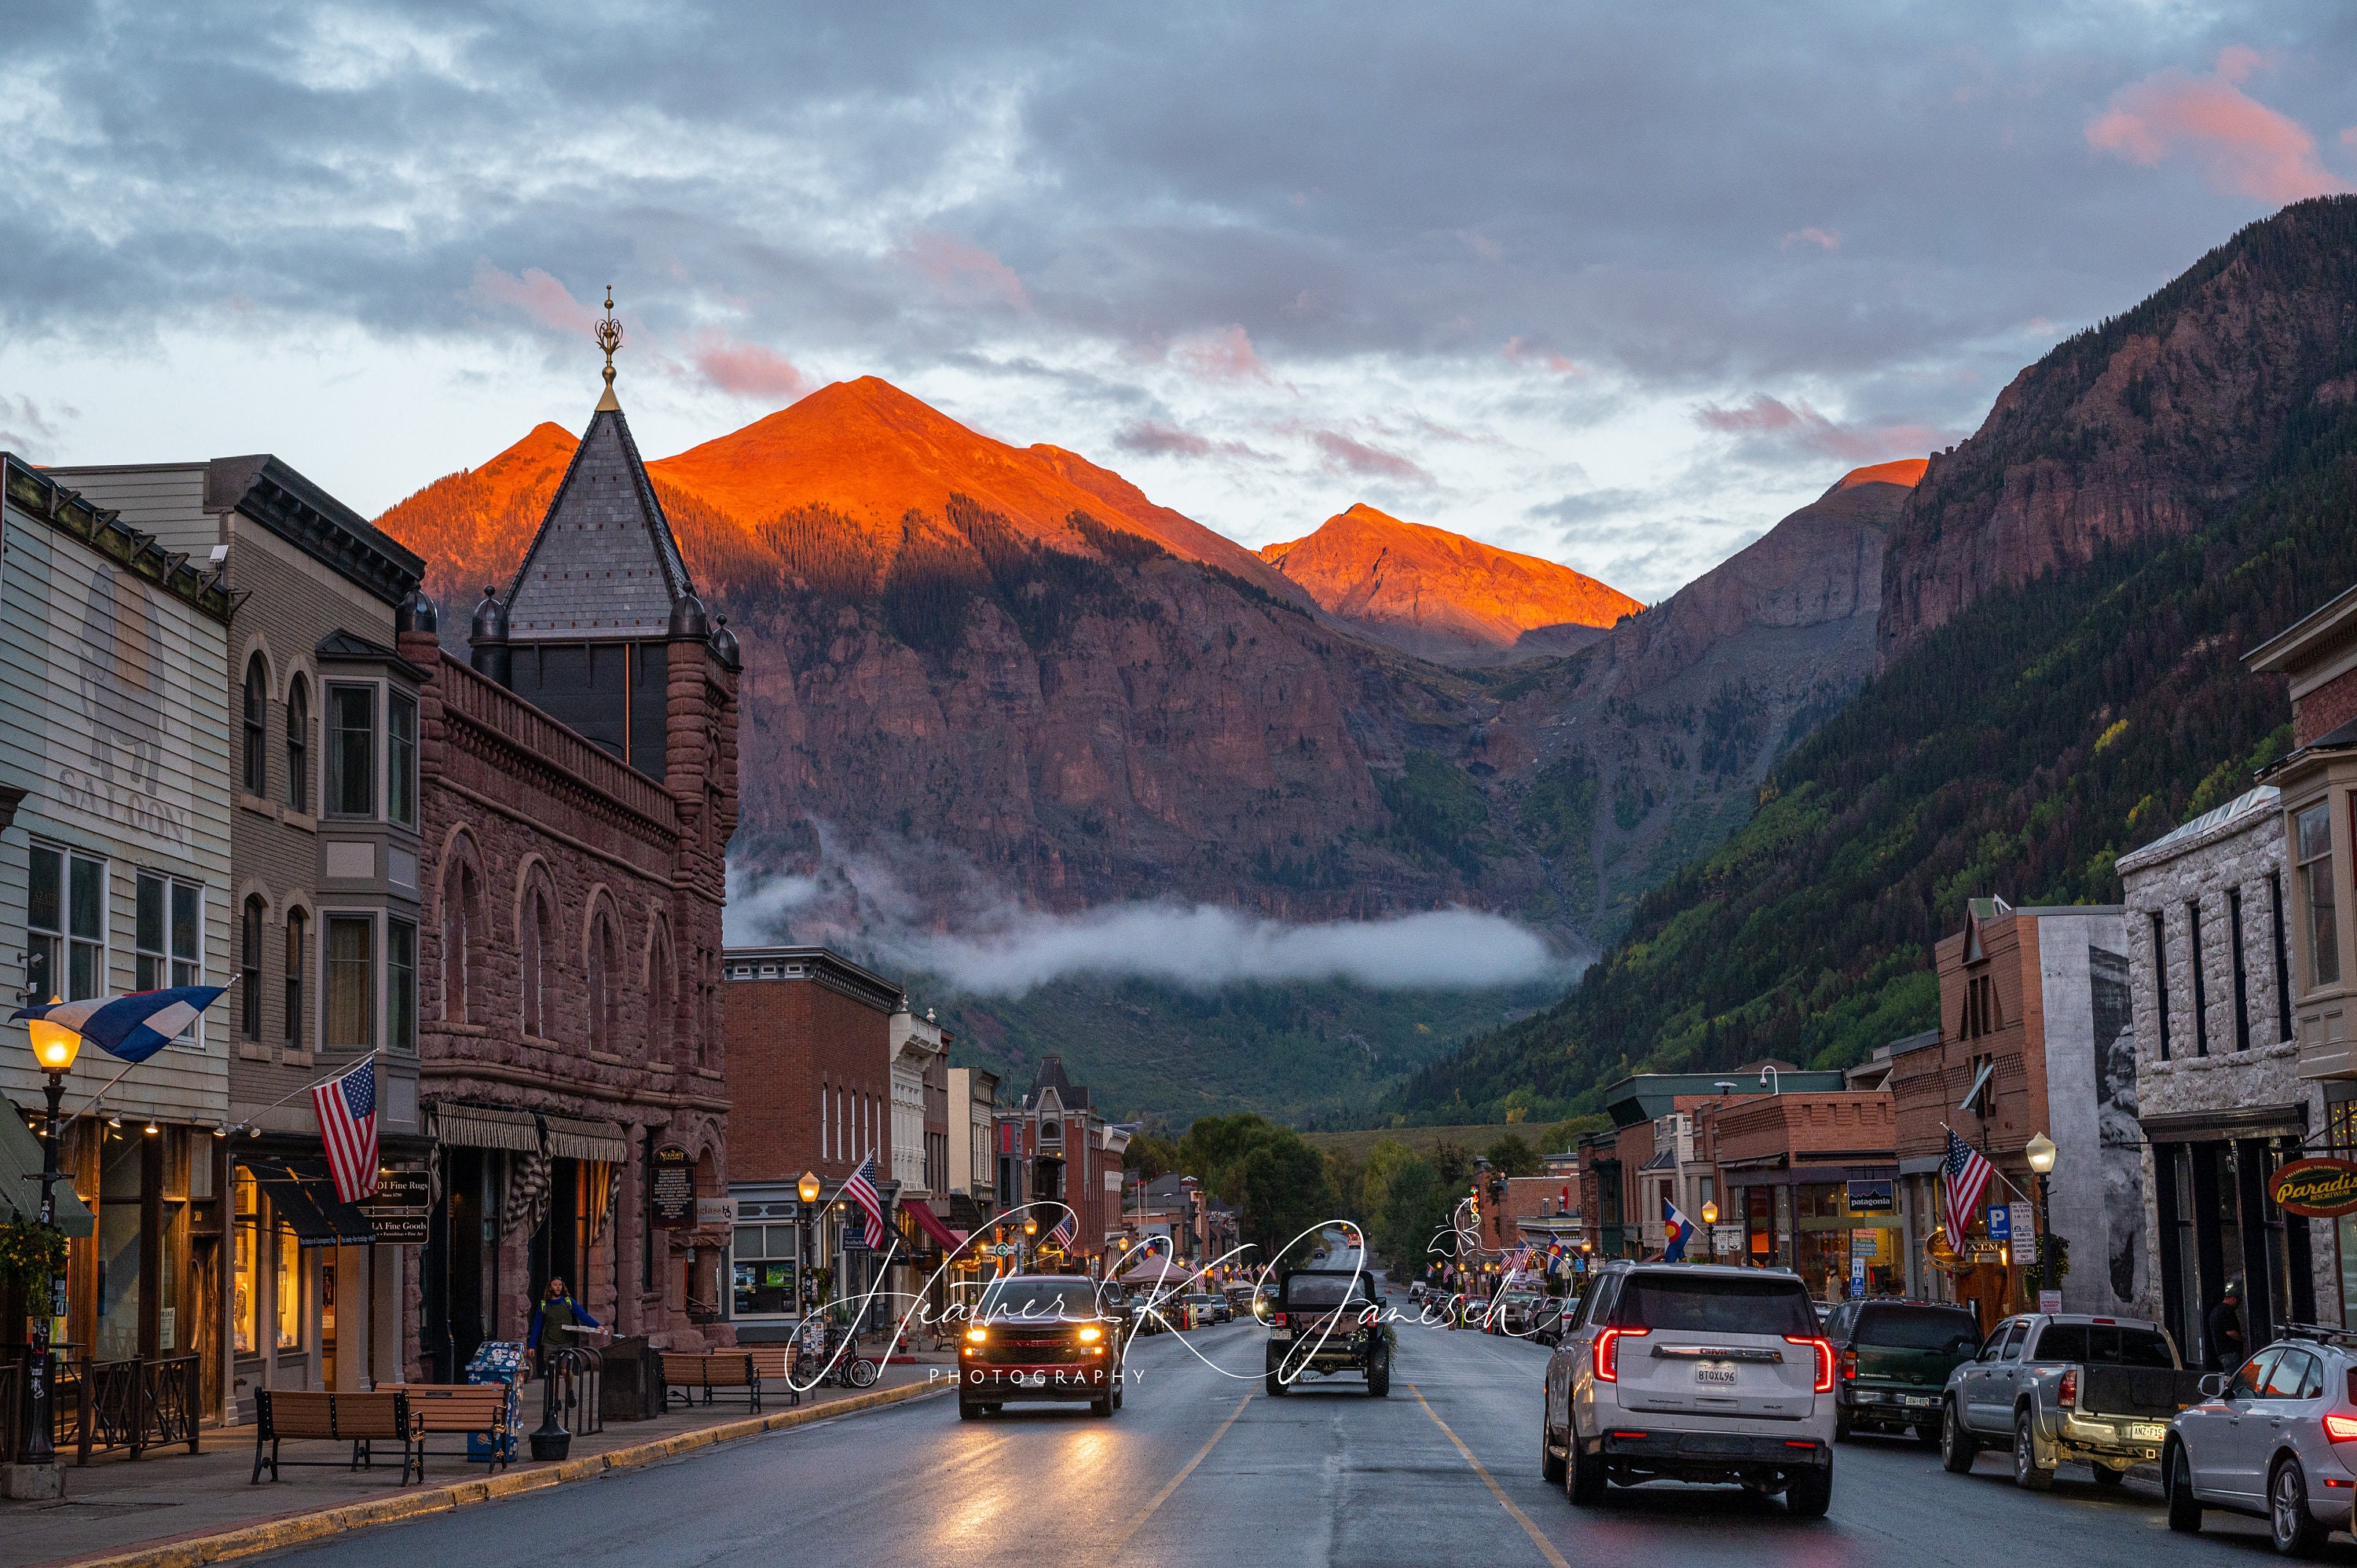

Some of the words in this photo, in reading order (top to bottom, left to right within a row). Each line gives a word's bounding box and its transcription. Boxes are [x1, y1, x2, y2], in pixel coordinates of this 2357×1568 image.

[58, 769, 185, 852] SALOON
[2285, 1166, 2313, 1179] TELLURIDE,
[390, 1181, 406, 1190] Fine
[409, 1181, 428, 1191] Rugs
[2310, 1189, 2351, 1201] RESORTWEAR
[1851, 1197, 1890, 1207] patagonia
[1991, 1210, 2005, 1228] P
[402, 1222, 427, 1230] Goods
[2134, 1427, 2162, 1437] ANZ-F15
